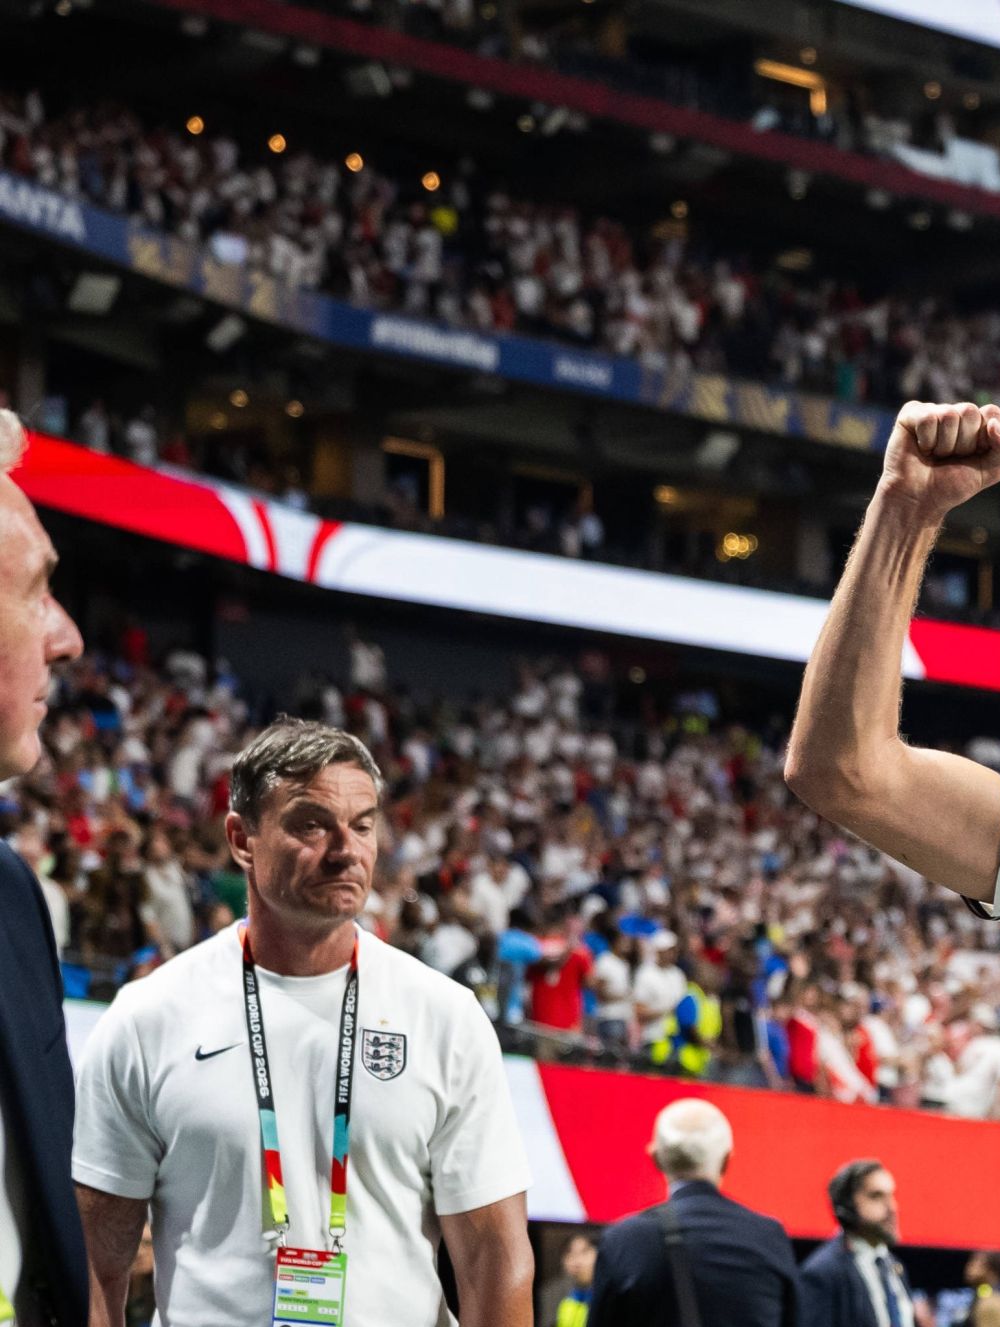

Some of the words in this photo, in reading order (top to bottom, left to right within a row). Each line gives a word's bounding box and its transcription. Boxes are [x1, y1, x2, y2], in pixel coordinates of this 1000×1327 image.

[247, 993, 261, 1032] WORLD
[343, 1015, 354, 1036] CUP
[252, 1034, 264, 1057] CUP
[341, 1037, 353, 1077] WORLD
[254, 1057, 270, 1099] 2026
[338, 1079, 349, 1103] FIFA
